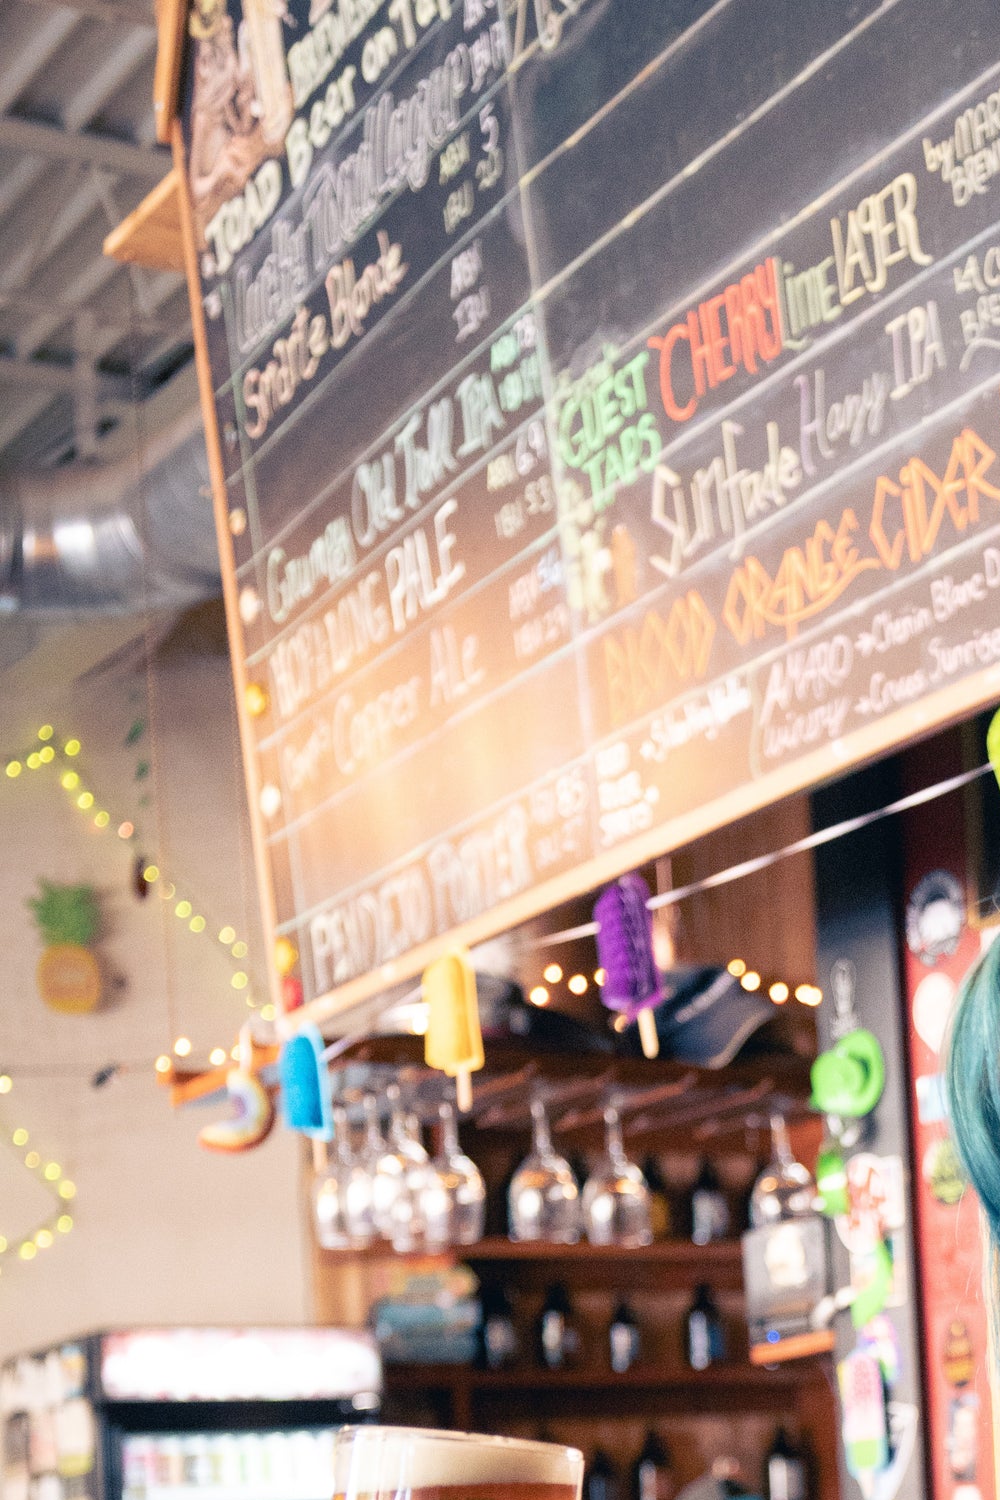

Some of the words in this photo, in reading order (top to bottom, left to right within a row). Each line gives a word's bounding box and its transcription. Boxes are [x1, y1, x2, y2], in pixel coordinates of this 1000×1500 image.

[286, 65, 356, 188] Beer
[361, 27, 398, 83] on
[647, 256, 781, 420] CHERRY
[886, 300, 947, 400] IPA
[560, 351, 649, 467] GUEST
[586, 413, 661, 510] TAPS
[386, 498, 466, 632] PALE
[601, 589, 716, 728] BLOOD
[721, 508, 868, 646] ORANGE
